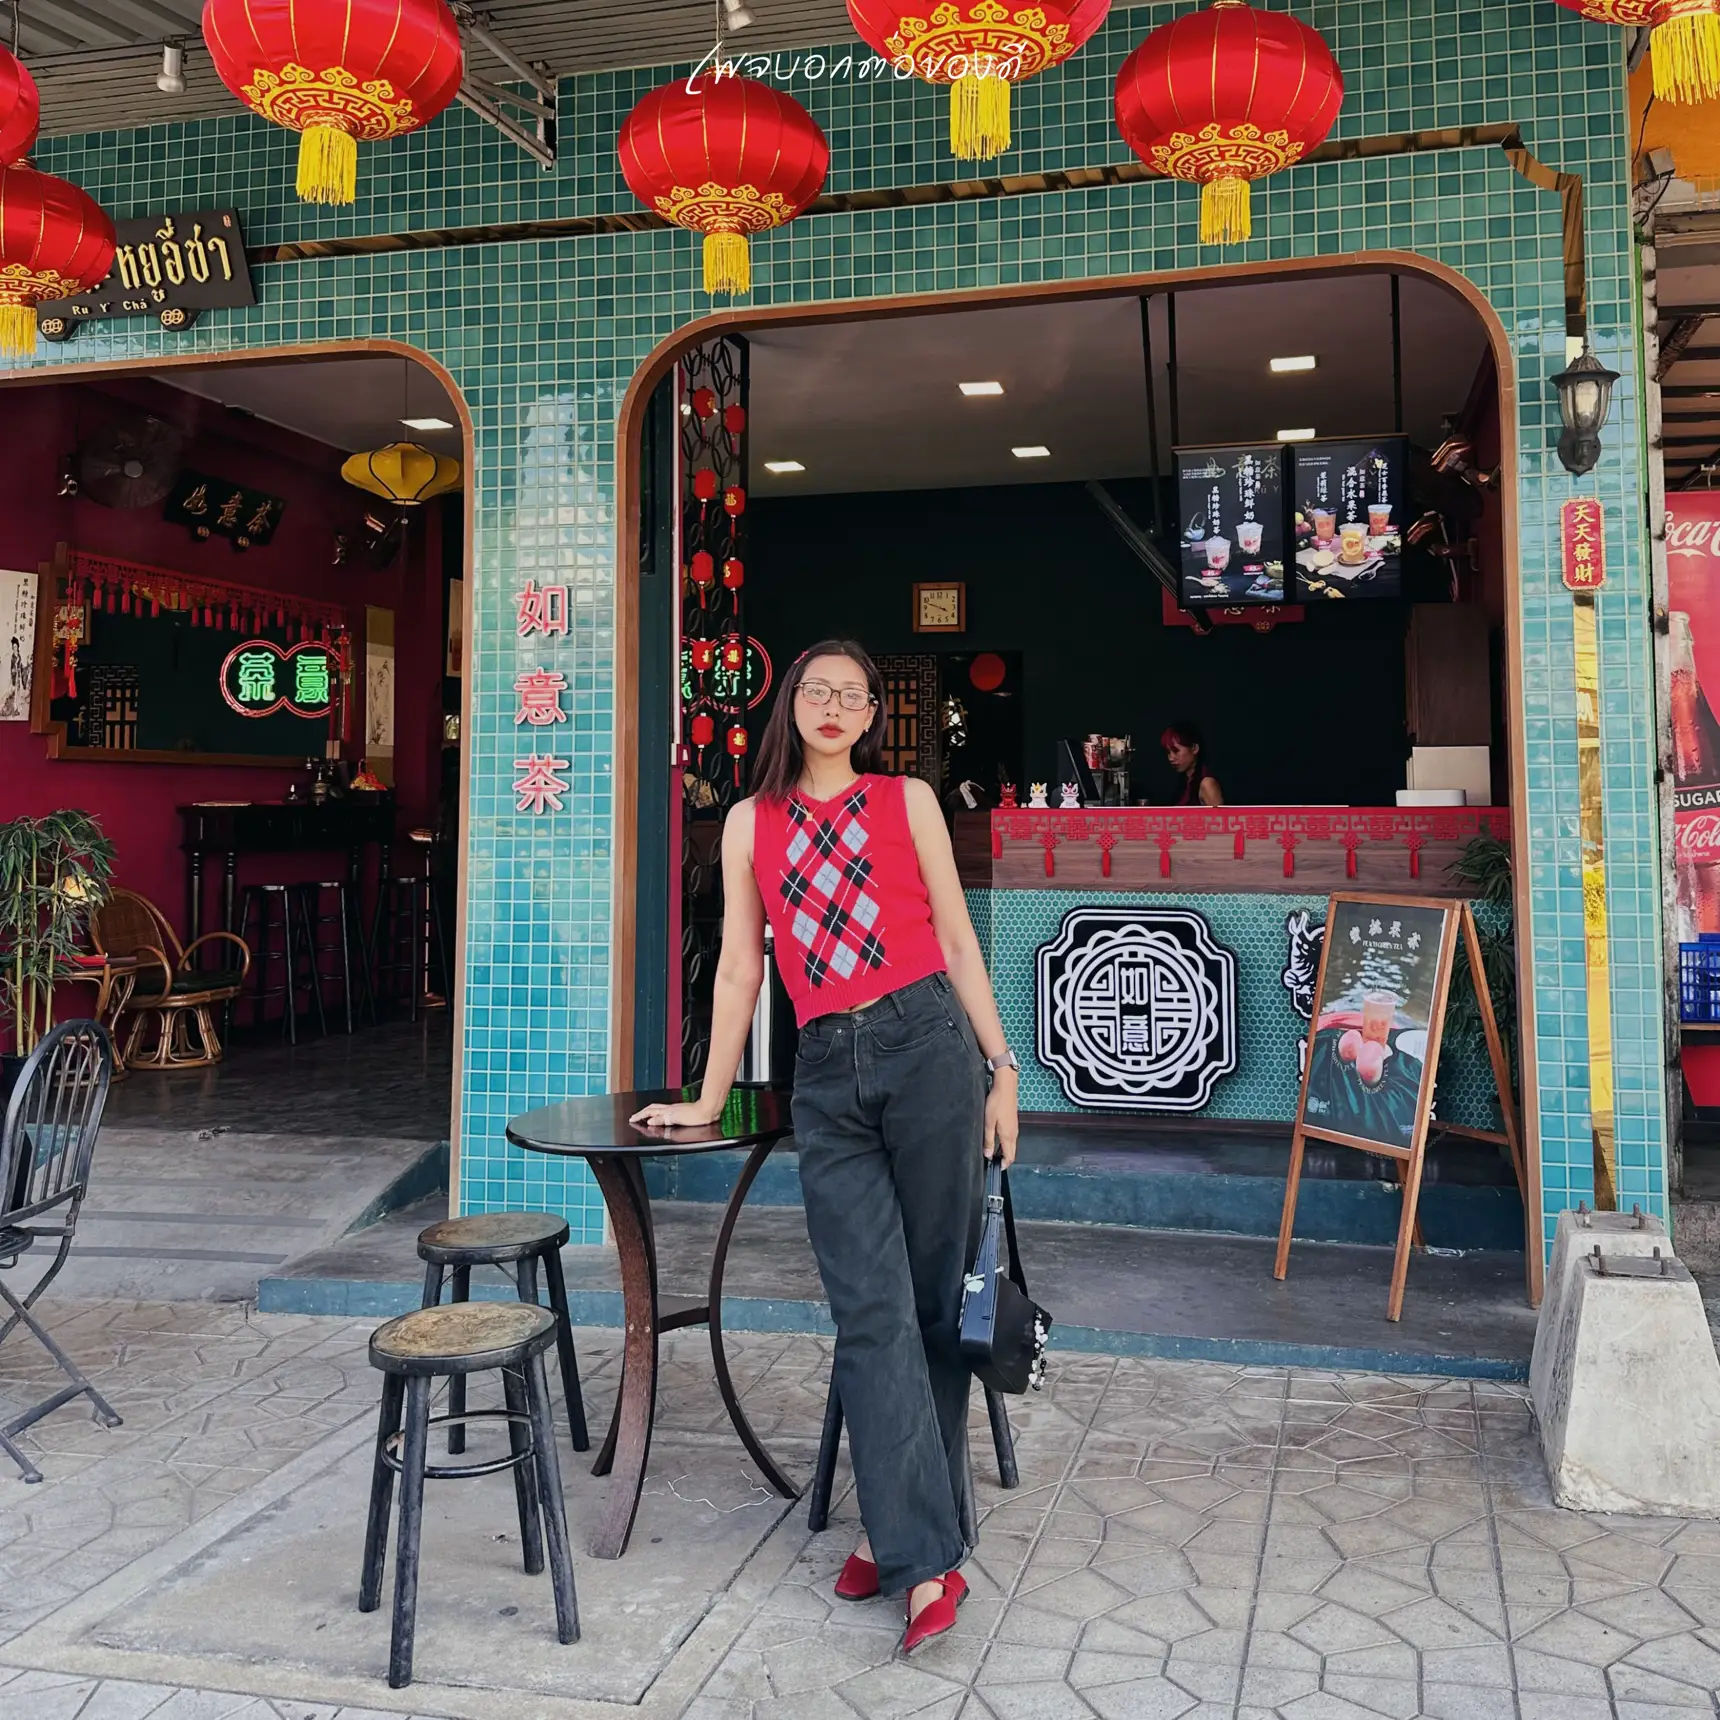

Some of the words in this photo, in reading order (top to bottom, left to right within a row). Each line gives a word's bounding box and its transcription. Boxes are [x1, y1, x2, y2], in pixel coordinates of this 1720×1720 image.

[1571, 503, 1597, 583] 天天發財
[511, 578, 570, 815] 如意茶
[1120, 967, 1150, 1053] 如意
